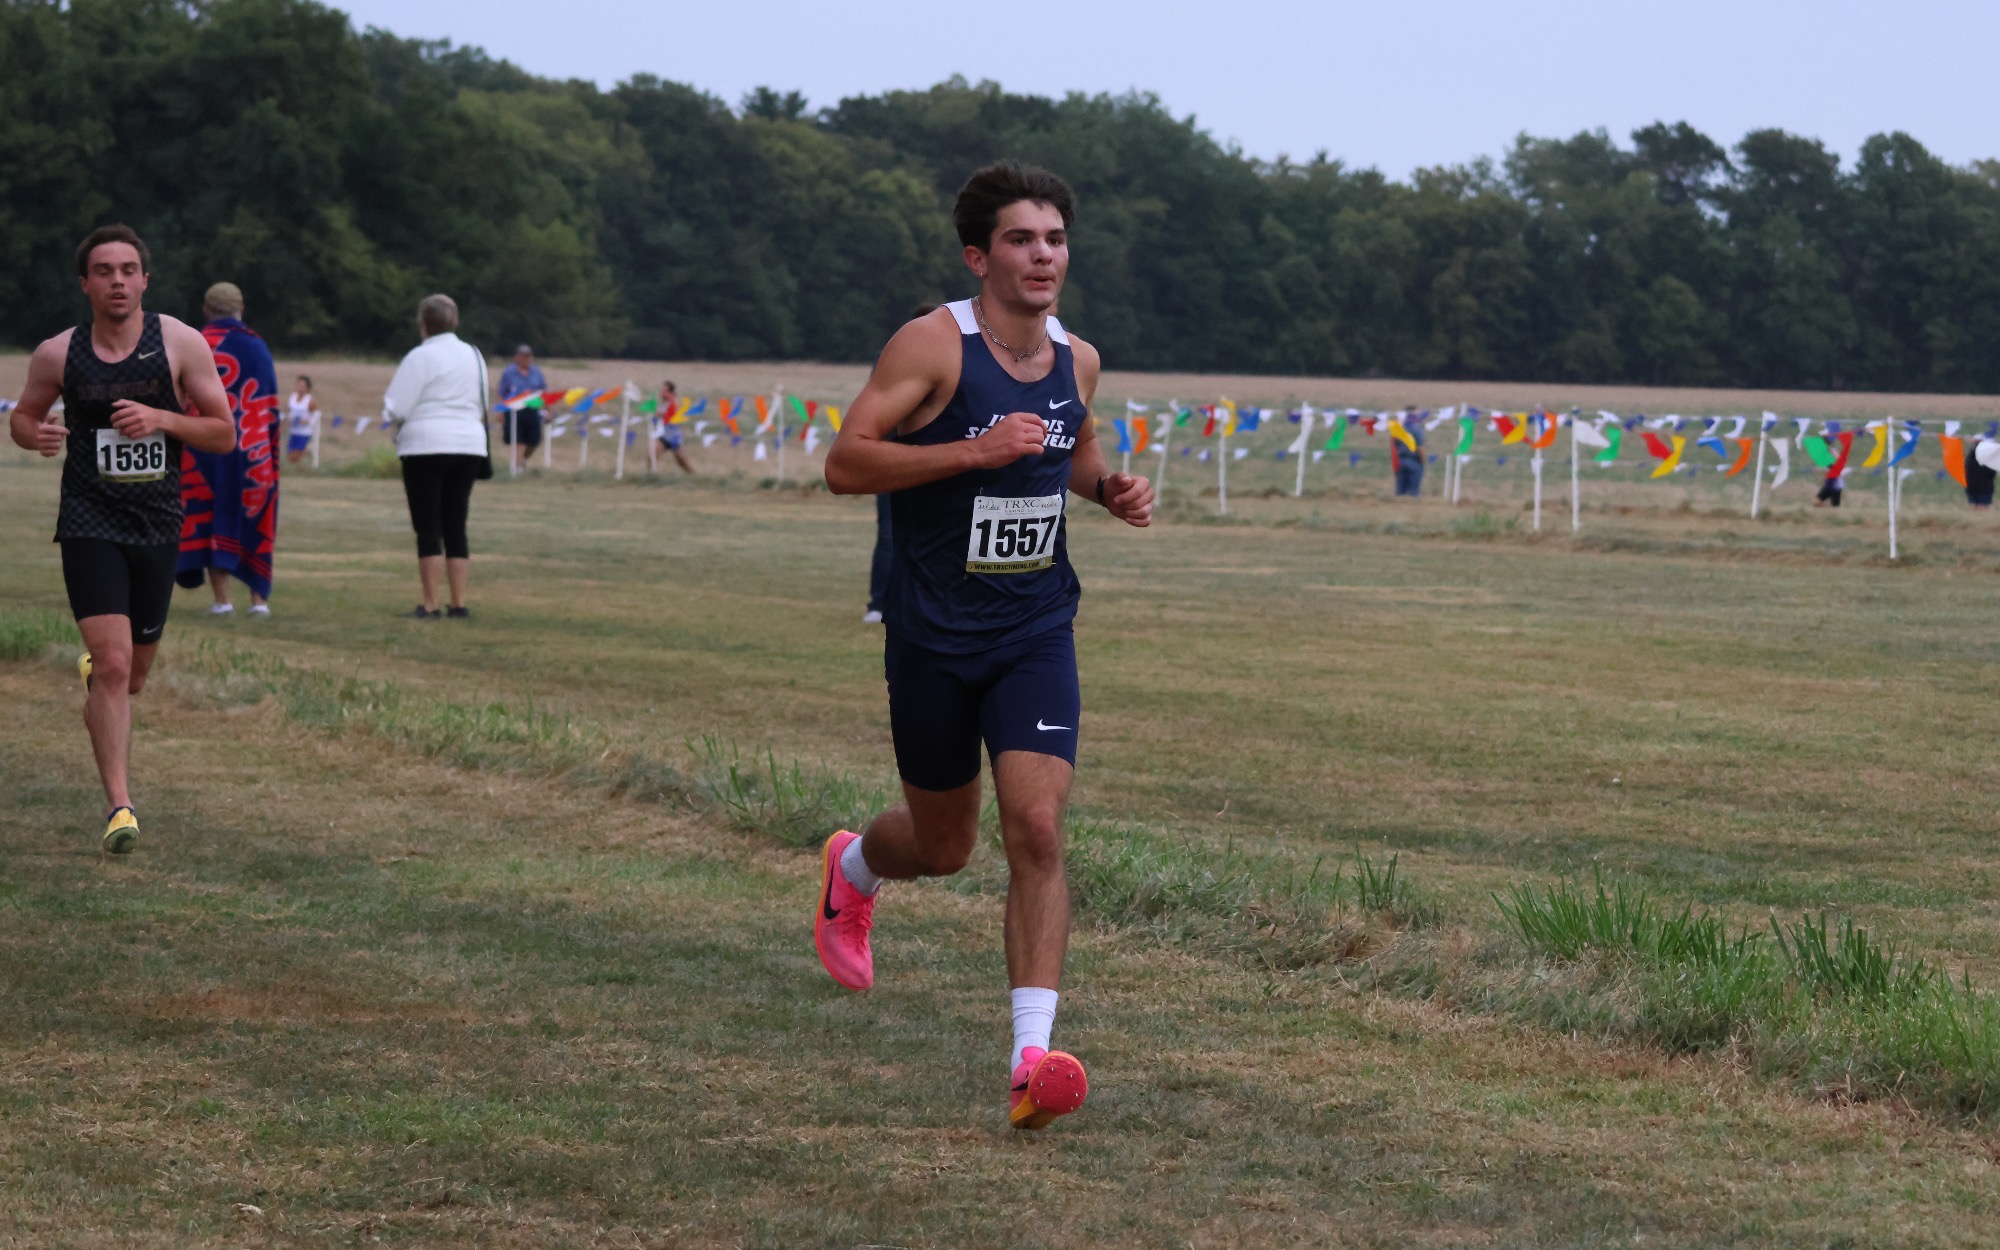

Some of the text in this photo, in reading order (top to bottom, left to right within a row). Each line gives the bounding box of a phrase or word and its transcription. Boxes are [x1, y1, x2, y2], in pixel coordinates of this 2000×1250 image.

[100, 441, 163, 471] 1536
[1002, 499, 1040, 509] TRXC
[976, 514, 1057, 558] 1557
